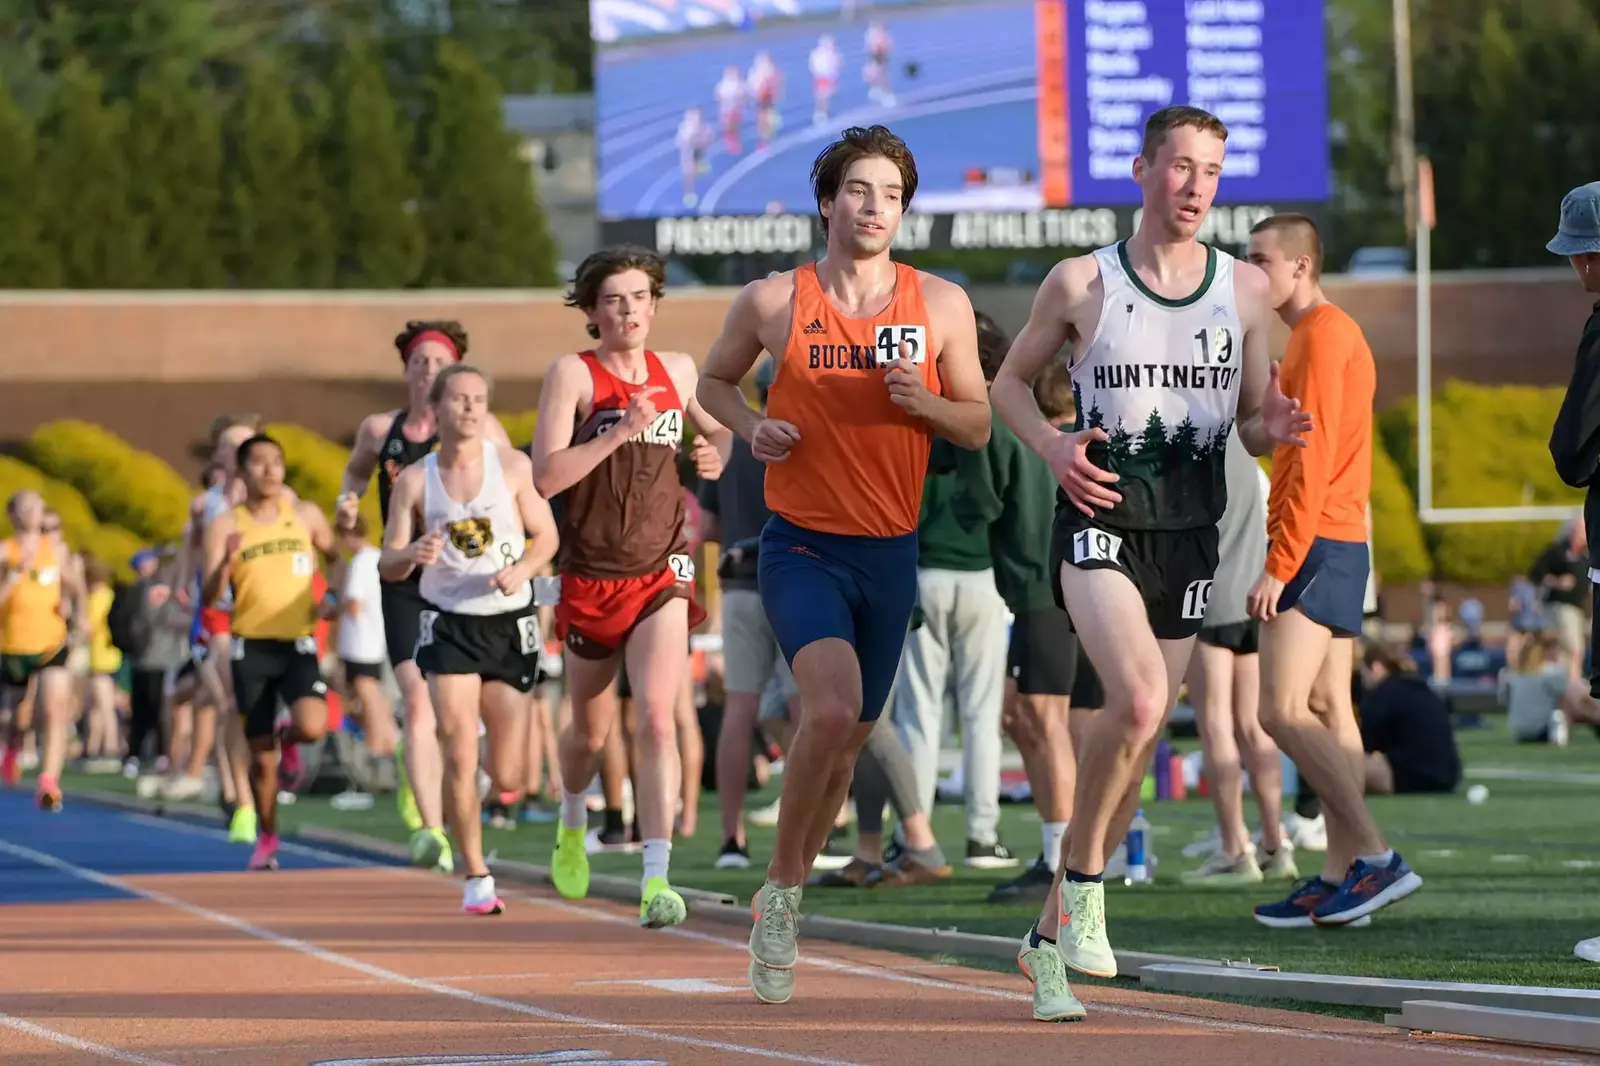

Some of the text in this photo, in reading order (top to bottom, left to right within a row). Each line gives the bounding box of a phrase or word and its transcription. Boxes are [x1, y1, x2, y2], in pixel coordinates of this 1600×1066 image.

[951, 208, 1116, 248] ATHLETICS
[809, 345, 888, 369] BUCKN
[877, 327, 919, 361] 45
[655, 412, 678, 437] 24
[1076, 530, 1111, 560] 19
[671, 557, 694, 578] 2
[526, 620, 535, 649] 8
